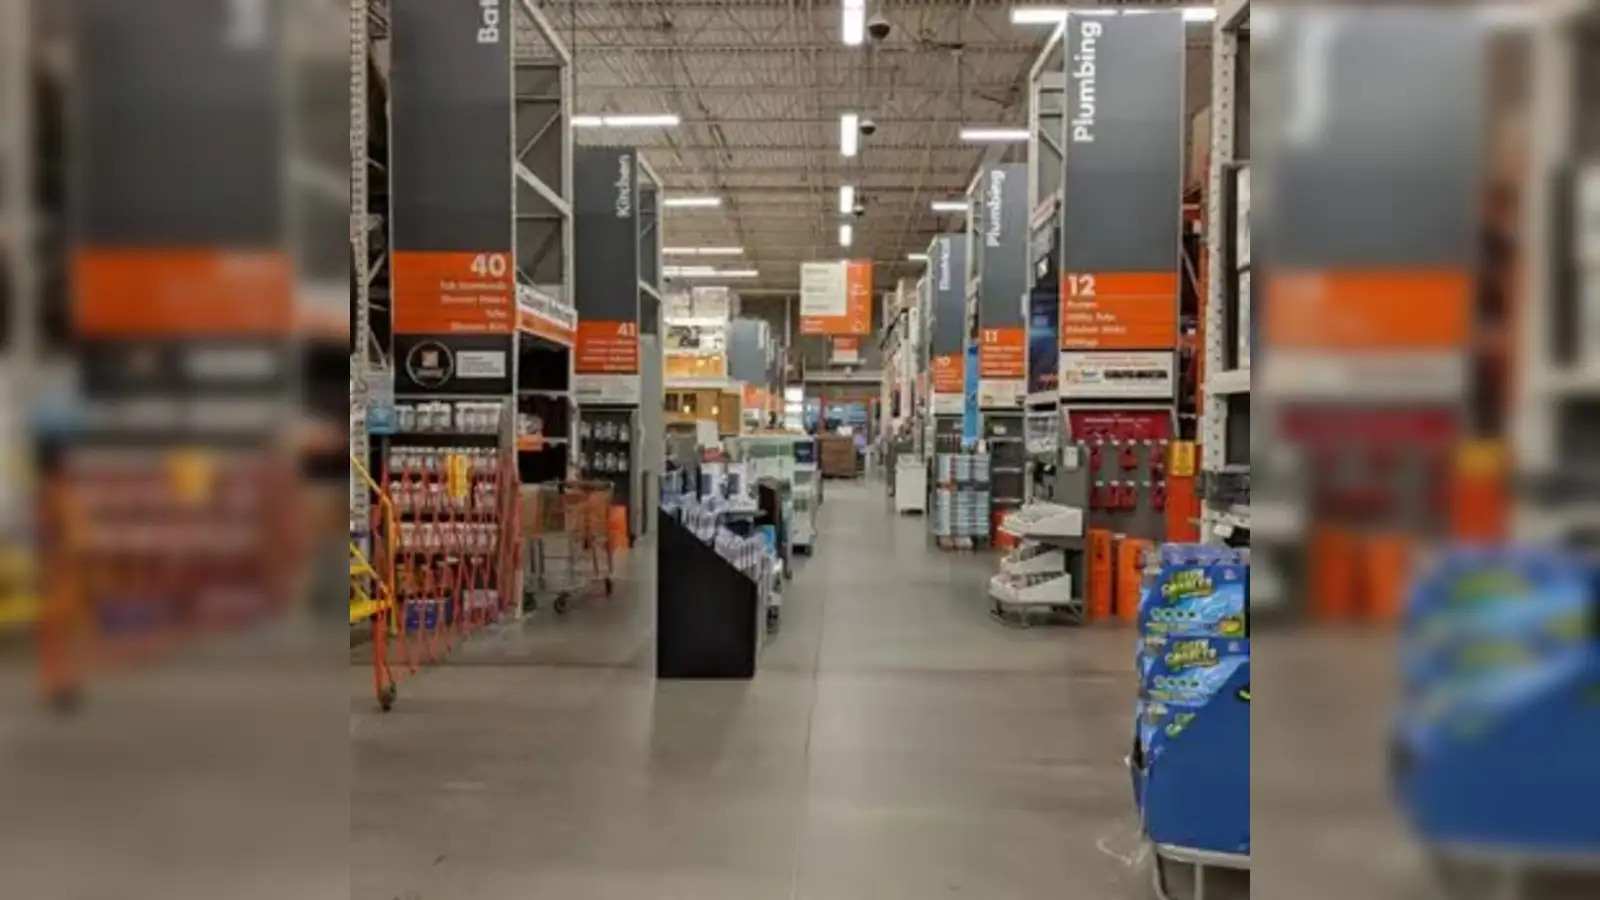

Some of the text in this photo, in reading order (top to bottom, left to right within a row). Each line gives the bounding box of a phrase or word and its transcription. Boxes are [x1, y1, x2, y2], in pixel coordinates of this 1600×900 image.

[1072, 20, 1101, 142] Plumbing
[614, 154, 631, 218] Kitchen
[987, 170, 1006, 247] Plumbing
[470, 254, 506, 278] 40
[1068, 275, 1096, 296] 12
[617, 322, 636, 337] 41
